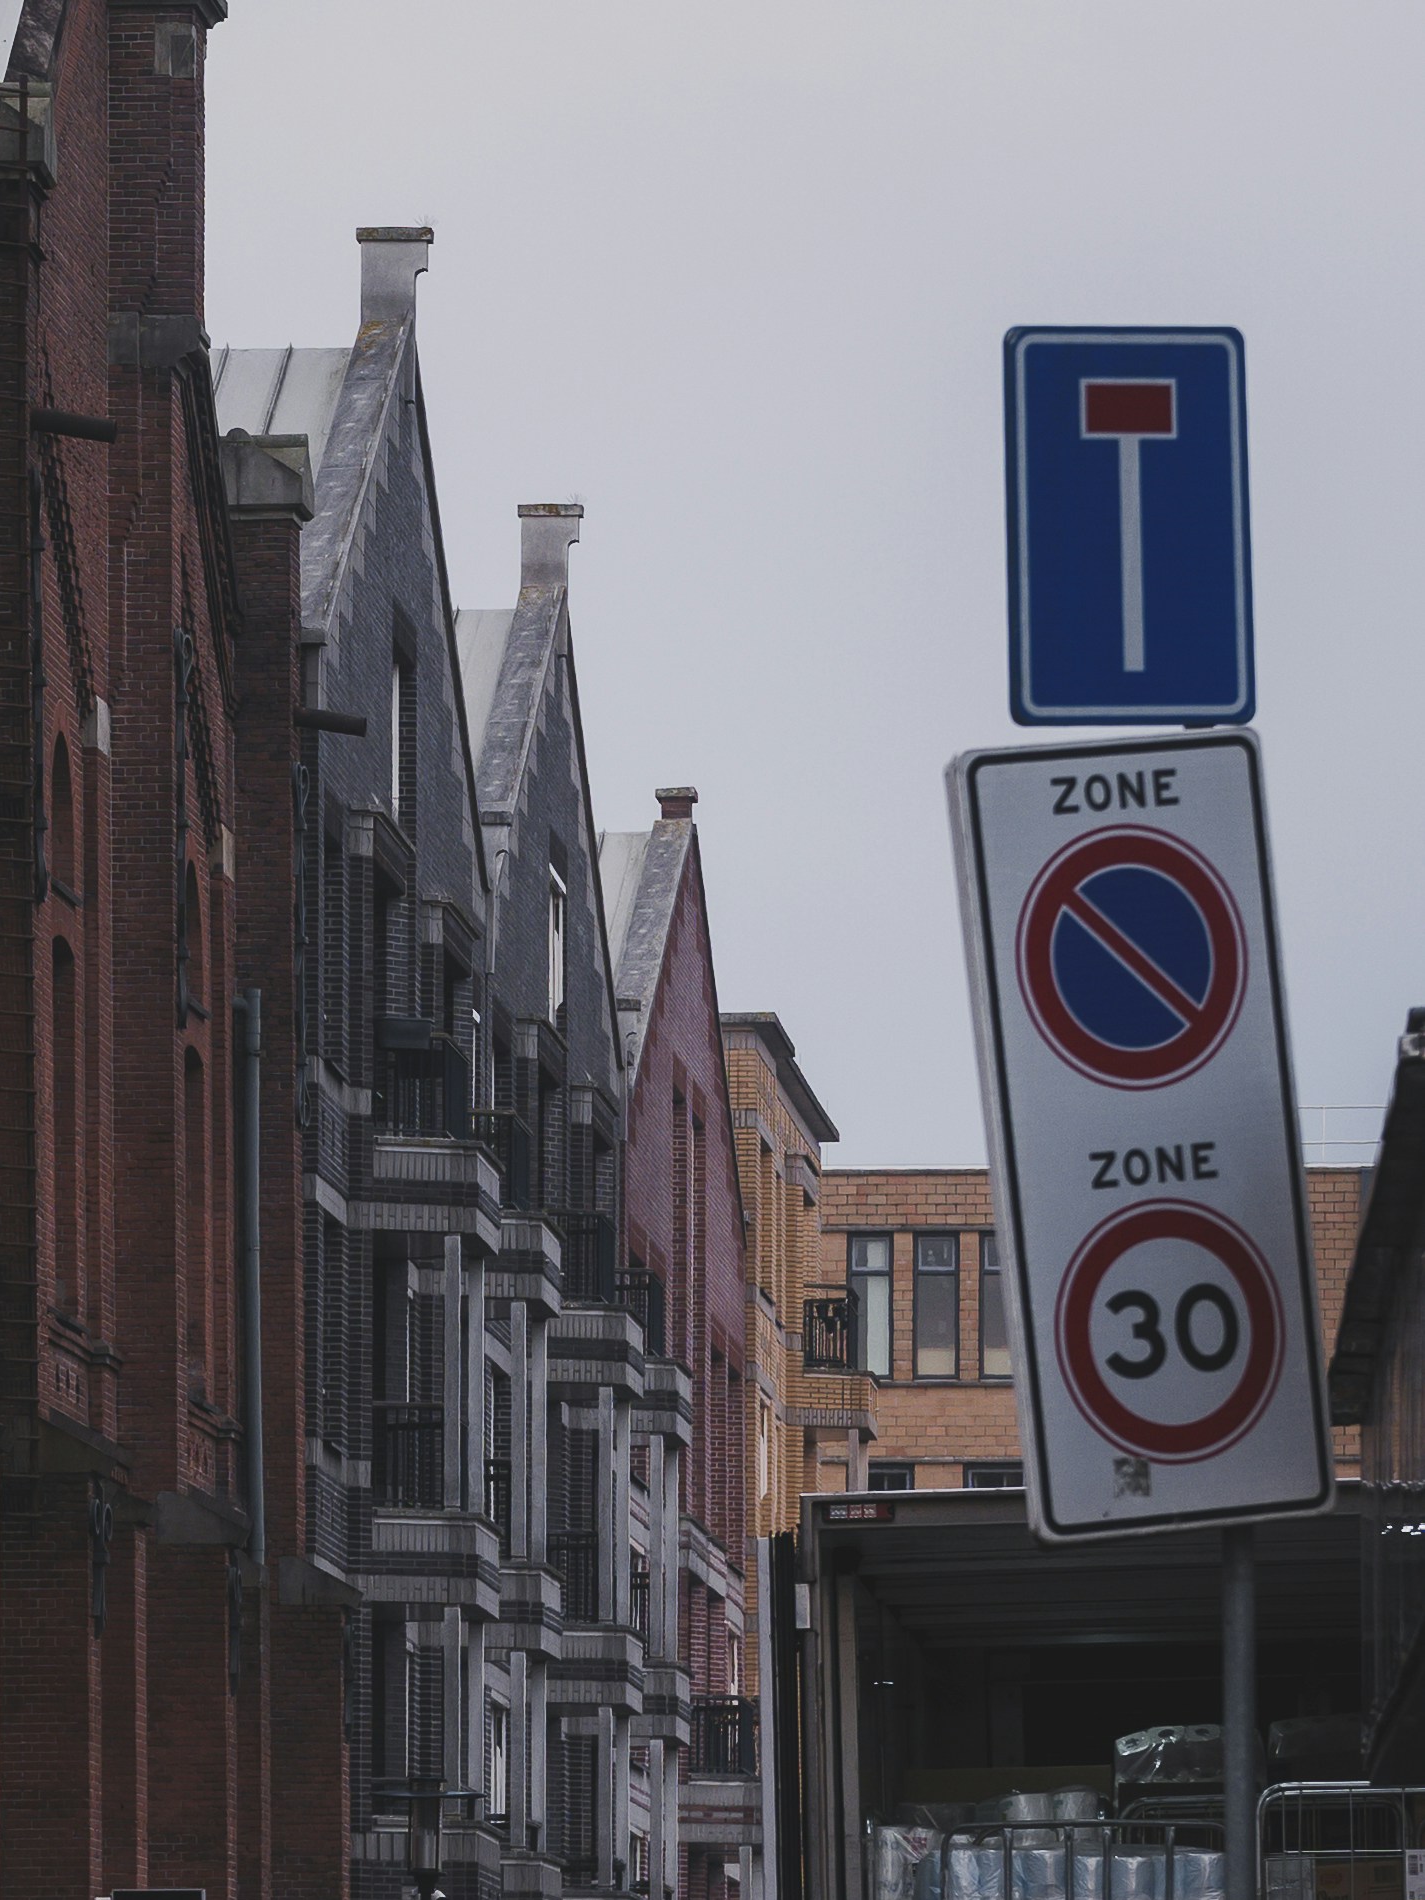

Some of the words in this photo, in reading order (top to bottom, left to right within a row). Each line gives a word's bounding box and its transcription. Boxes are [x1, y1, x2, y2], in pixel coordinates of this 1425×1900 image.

[1050, 769, 1180, 814] ZONE
[1089, 1143, 1218, 1189] ZONE
[1106, 1283, 1239, 1380] 30
